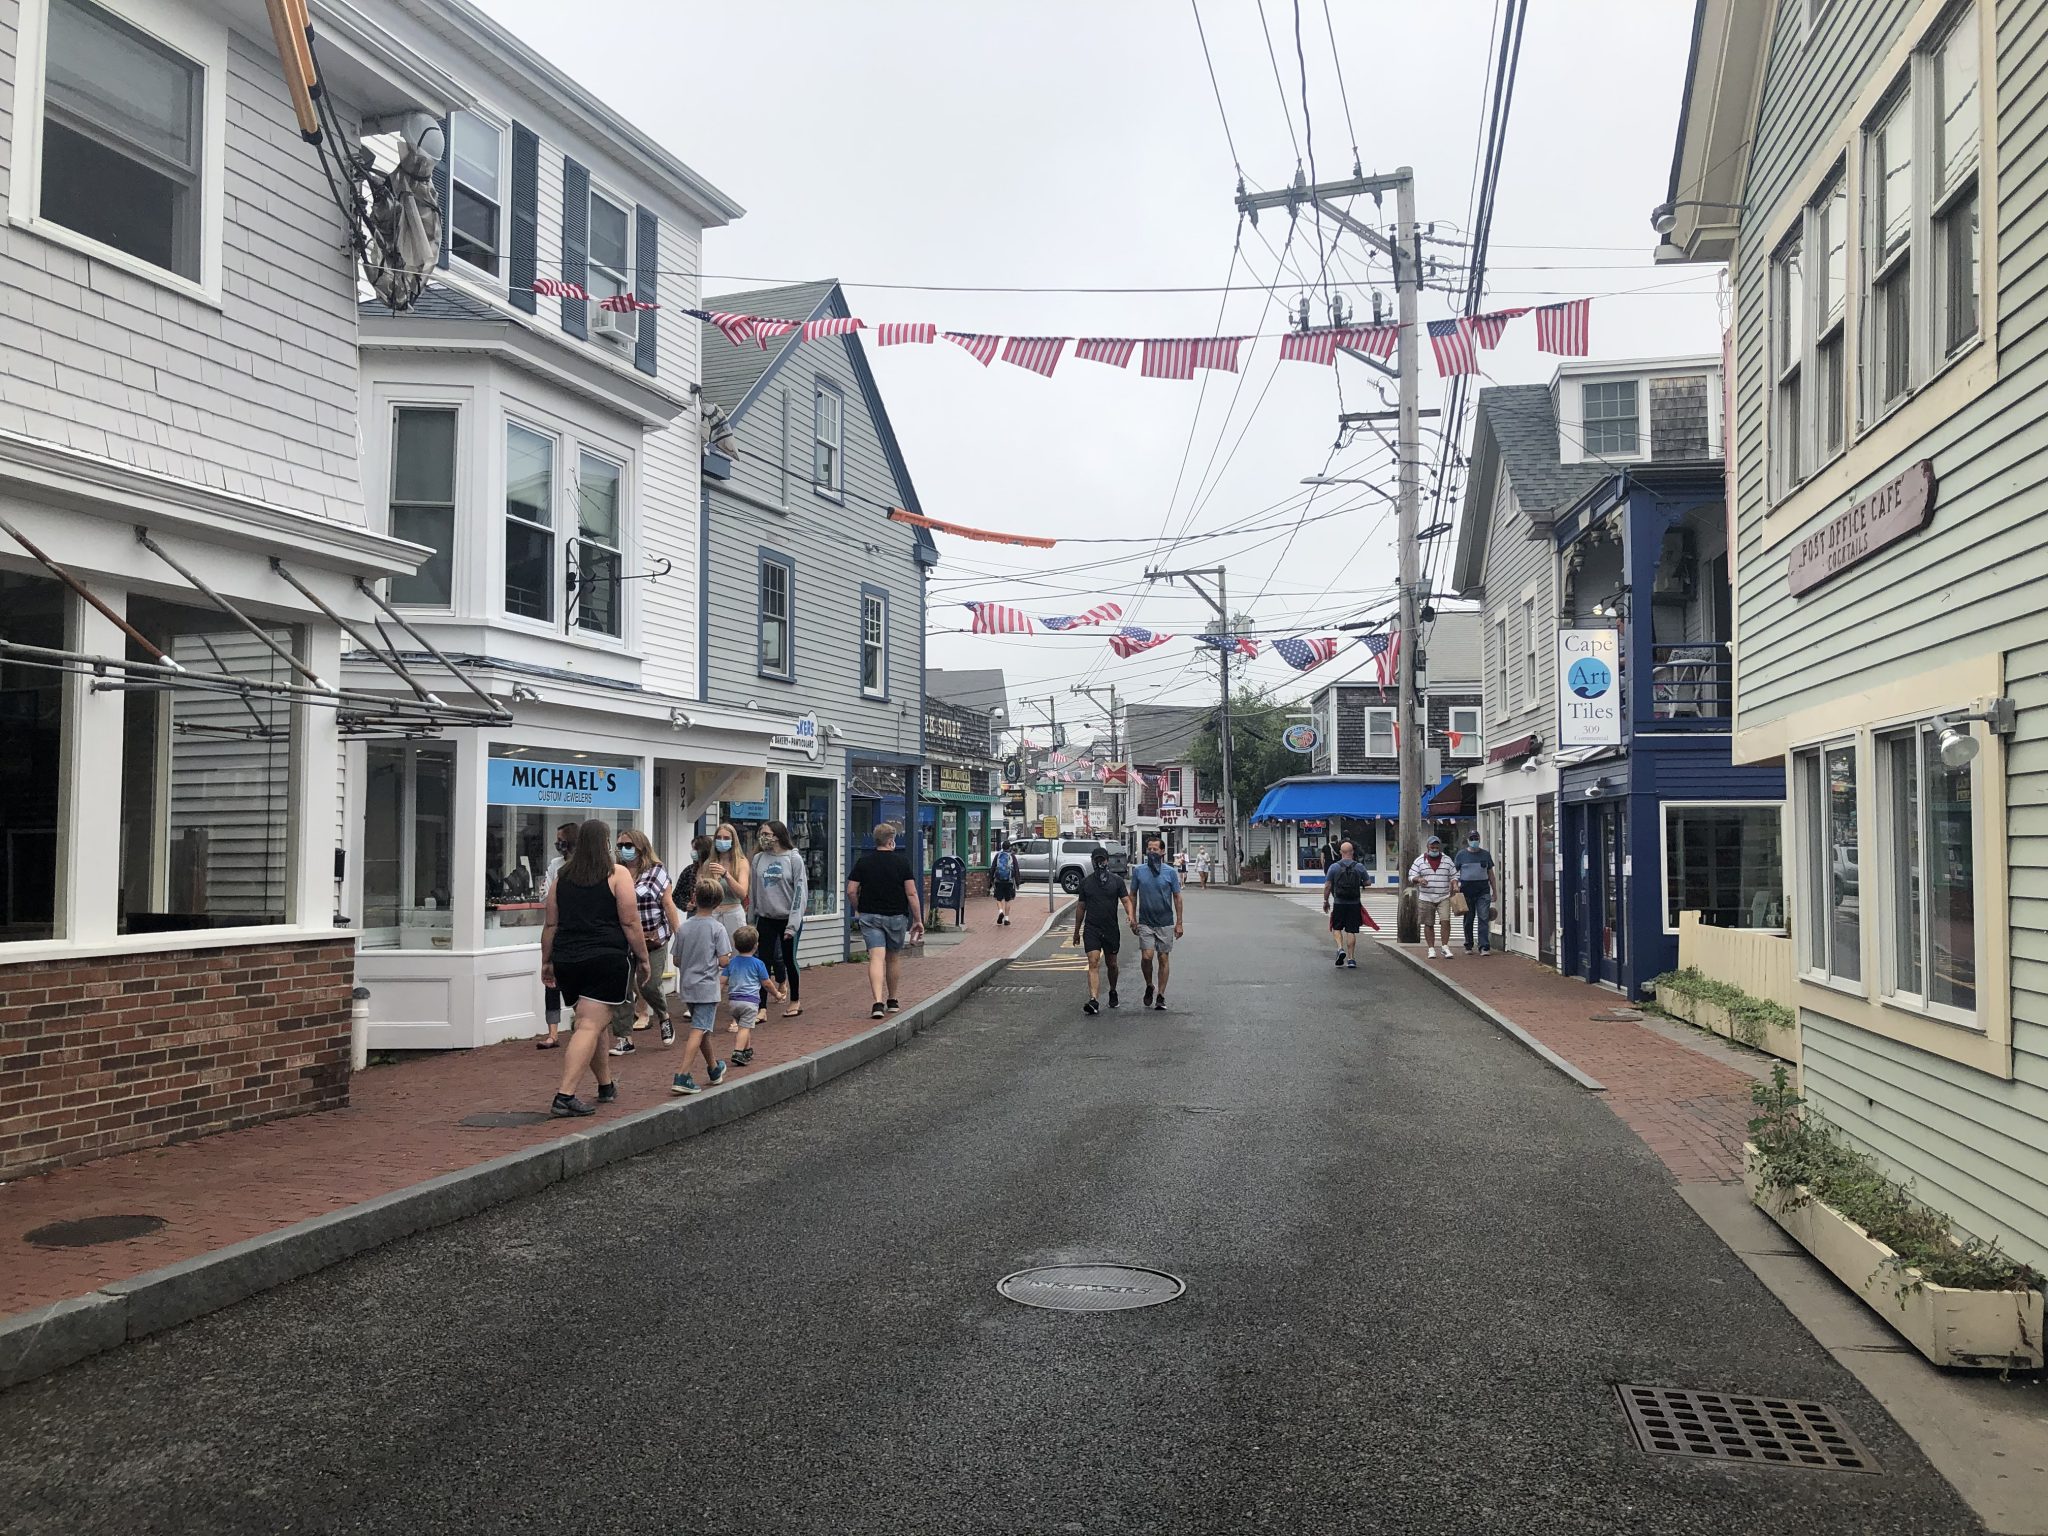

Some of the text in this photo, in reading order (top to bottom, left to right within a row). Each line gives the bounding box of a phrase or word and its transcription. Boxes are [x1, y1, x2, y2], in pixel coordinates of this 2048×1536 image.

[1799, 531, 1825, 568] POST
[1828, 504, 1867, 549] OFFICE
[1828, 532, 1868, 571] COCKTAILS
[1565, 635, 1613, 656] Cape
[1571, 666, 1609, 684] Art
[1567, 702, 1613, 719] Tiles
[938, 718, 960, 739] STORE
[1583, 725, 1600, 734] 309
[775, 736, 789, 745] BAKERY
[512, 766, 617, 792] MICHAEL'S
[538, 790, 592, 803] CUSTOM JEWELERS
[1164, 817, 1178, 825] POT
